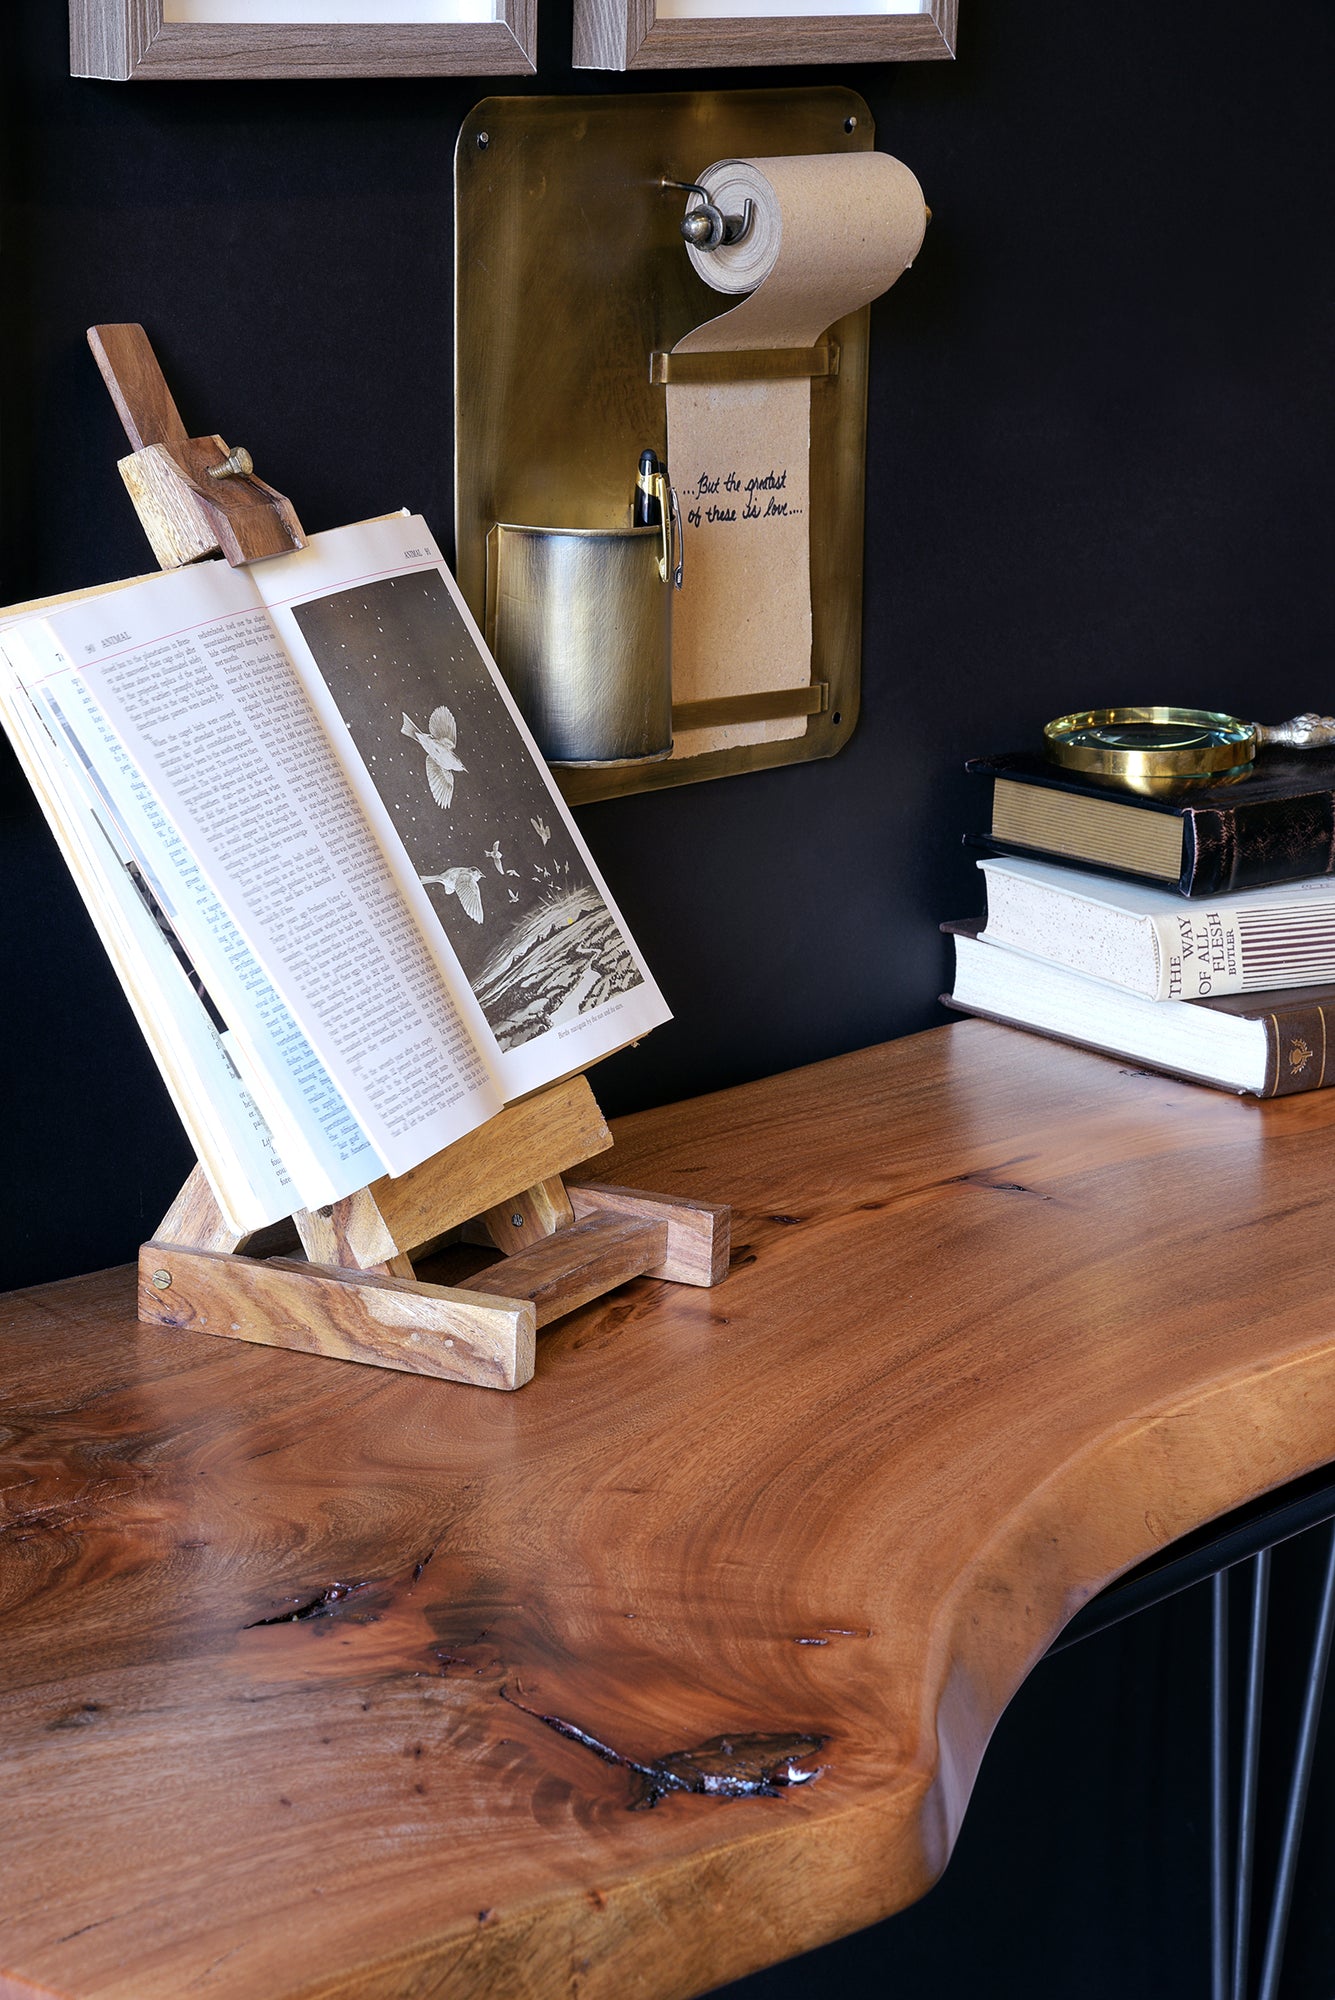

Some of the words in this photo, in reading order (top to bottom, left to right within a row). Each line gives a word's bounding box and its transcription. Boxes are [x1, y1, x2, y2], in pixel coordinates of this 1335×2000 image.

[724, 472, 741, 492] the
[744, 470, 787, 506] greatest
[688, 507, 702, 528] of
[706, 505, 737, 523] these
[742, 498, 762, 519] is
[100, 631, 132, 648] ANIMAL
[1177, 916, 1194, 960] WAY
[1196, 927, 1210, 963] ALL
[1206, 912, 1226, 972] FLESH
[1226, 928, 1237, 976] BUTLER
[1168, 956, 1182, 998] THE
[1198, 971, 1212, 995] OF
